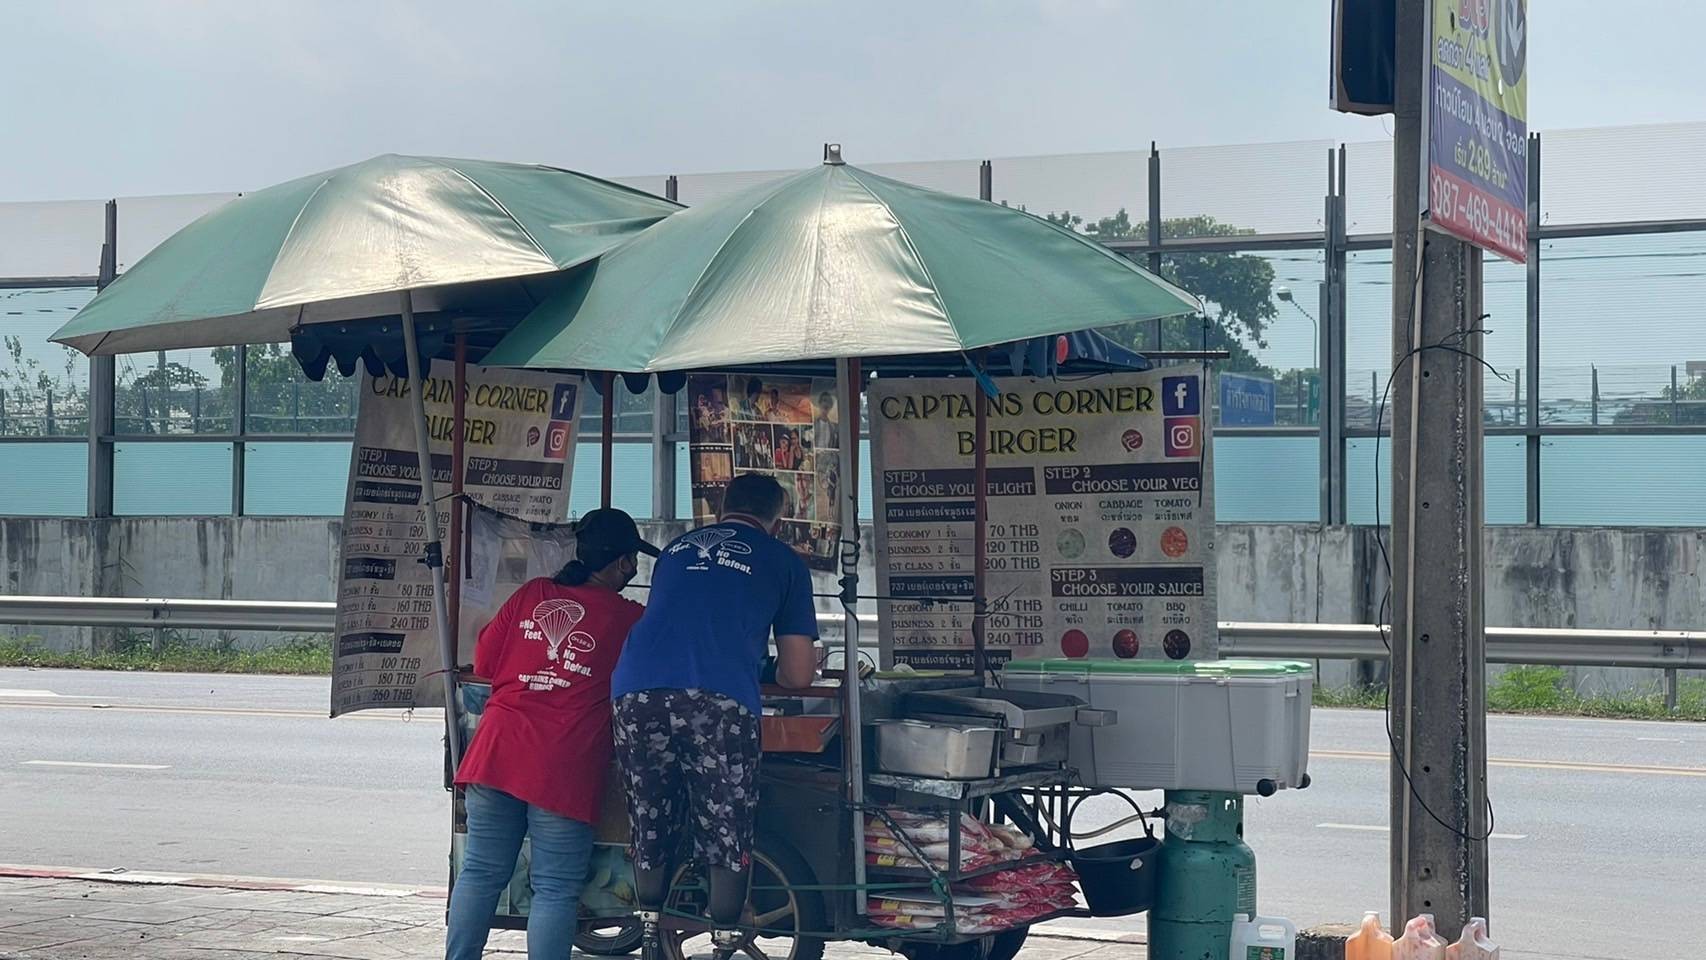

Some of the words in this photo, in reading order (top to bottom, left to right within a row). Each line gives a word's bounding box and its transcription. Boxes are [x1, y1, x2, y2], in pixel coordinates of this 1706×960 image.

[1465, 32, 1474, 74] 4
[1468, 139, 1490, 181] 2.89
[475, 384, 549, 414] CORNER
[880, 390, 1023, 421] CAPTANS
[1032, 386, 1155, 415] CORNER
[360, 448, 382, 461] STEP
[360, 463, 397, 477] CHOOSE
[400, 466, 421, 479] YOU
[469, 458, 491, 471] STEP
[482, 473, 516, 486] CHOOSE
[885, 471, 917, 483] STEP
[920, 471, 926, 482] 1
[1046, 467, 1080, 479] STEP
[1083, 467, 1091, 478] 2
[891, 483, 945, 496] CHOOSE
[949, 483, 975, 496] YOU
[987, 482, 1033, 495] FLIGHT
[1072, 480, 1129, 492] CHOOSE
[1133, 479, 1168, 491] YOUR
[1171, 478, 1199, 490] VEG
[1054, 502, 1082, 510] ONION
[1099, 499, 1143, 509] CABBAGE
[1155, 499, 1192, 508] TOMATO
[887, 529, 931, 539] ECONOMY
[989, 524, 1006, 537] 70
[1010, 524, 1039, 537] THB
[716, 549, 730, 558] No
[887, 545, 931, 554] BUSINESS
[1011, 540, 1039, 553] THB
[717, 557, 752, 575] Defeat.
[905, 562, 933, 570] CLASS
[984, 557, 1006, 570] 200
[1010, 556, 1040, 570] THB
[1052, 570, 1085, 582] STEP
[1089, 569, 1097, 581] 3
[415, 584, 434, 597] THB
[1062, 583, 1117, 595] CHOOSE
[1121, 583, 1155, 595] YOUR
[1158, 582, 1202, 595] SAUCE
[396, 600, 410, 613] 160
[413, 601, 431, 613] THB
[993, 599, 1009, 612] 80
[1014, 599, 1042, 612] THB
[1059, 603, 1088, 612] CHILLI
[1107, 602, 1143, 611] TOMATO
[1166, 602, 1185, 612] BBQ
[410, 616, 430, 629] THB
[891, 619, 935, 629] BUSINESS
[990, 616, 1009, 628] 160
[1014, 615, 1043, 628] THB
[987, 632, 1010, 645] 240
[1015, 631, 1044, 644] THB
[562, 648, 576, 661] No
[381, 658, 397, 669] 100
[400, 657, 421, 670] THB
[377, 673, 393, 685] 180
[396, 672, 417, 685] THB
[393, 688, 413, 701] THB
